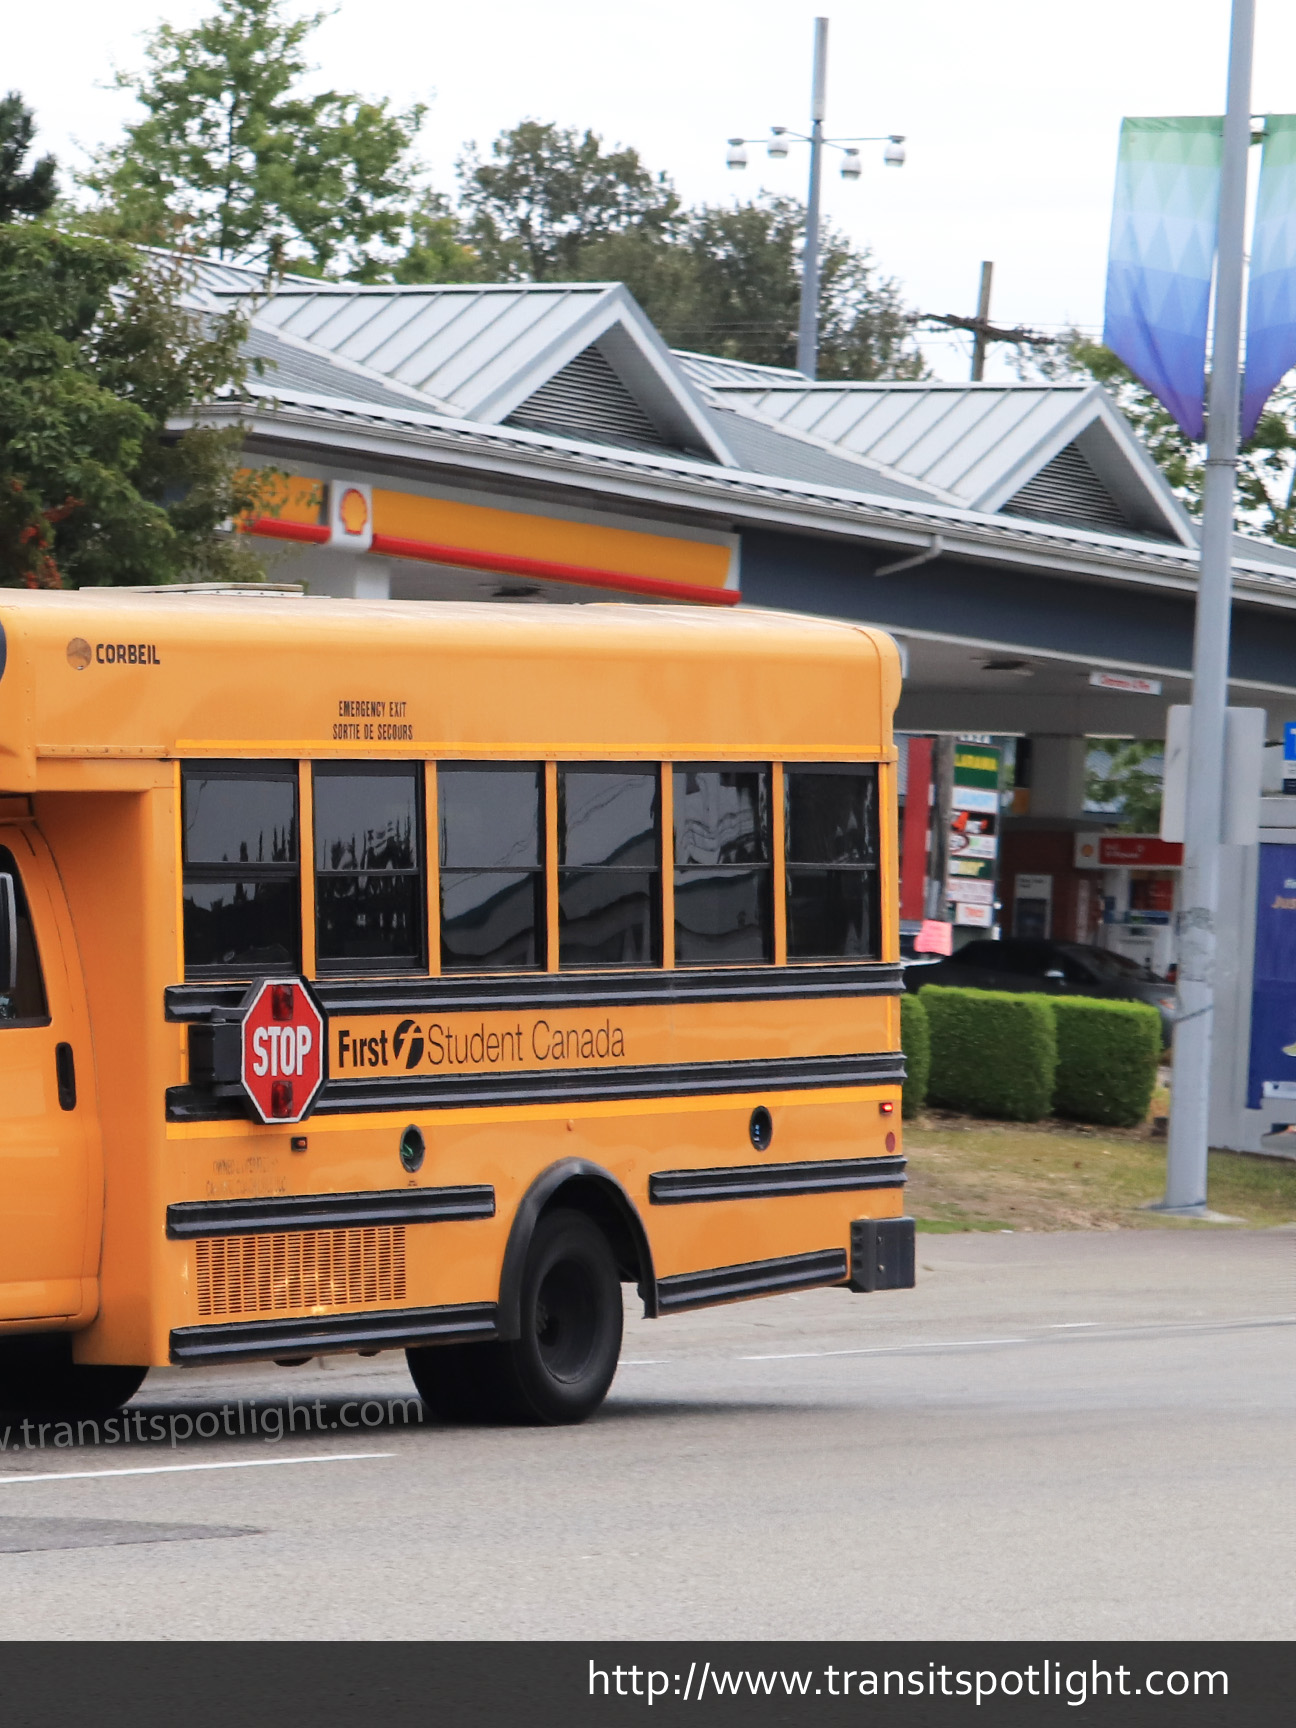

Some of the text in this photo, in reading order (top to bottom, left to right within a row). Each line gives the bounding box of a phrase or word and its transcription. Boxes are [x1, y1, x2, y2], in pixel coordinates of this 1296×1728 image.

[96, 643, 161, 665] CORBEIL
[338, 700, 407, 718] EMERGENCY EXIT
[332, 723, 413, 740] SORTIE DE SECOURS
[253, 1025, 312, 1077] STOP
[337, 1029, 389, 1068] First
[427, 1023, 524, 1066] Student
[531, 1018, 626, 1061] Canada
